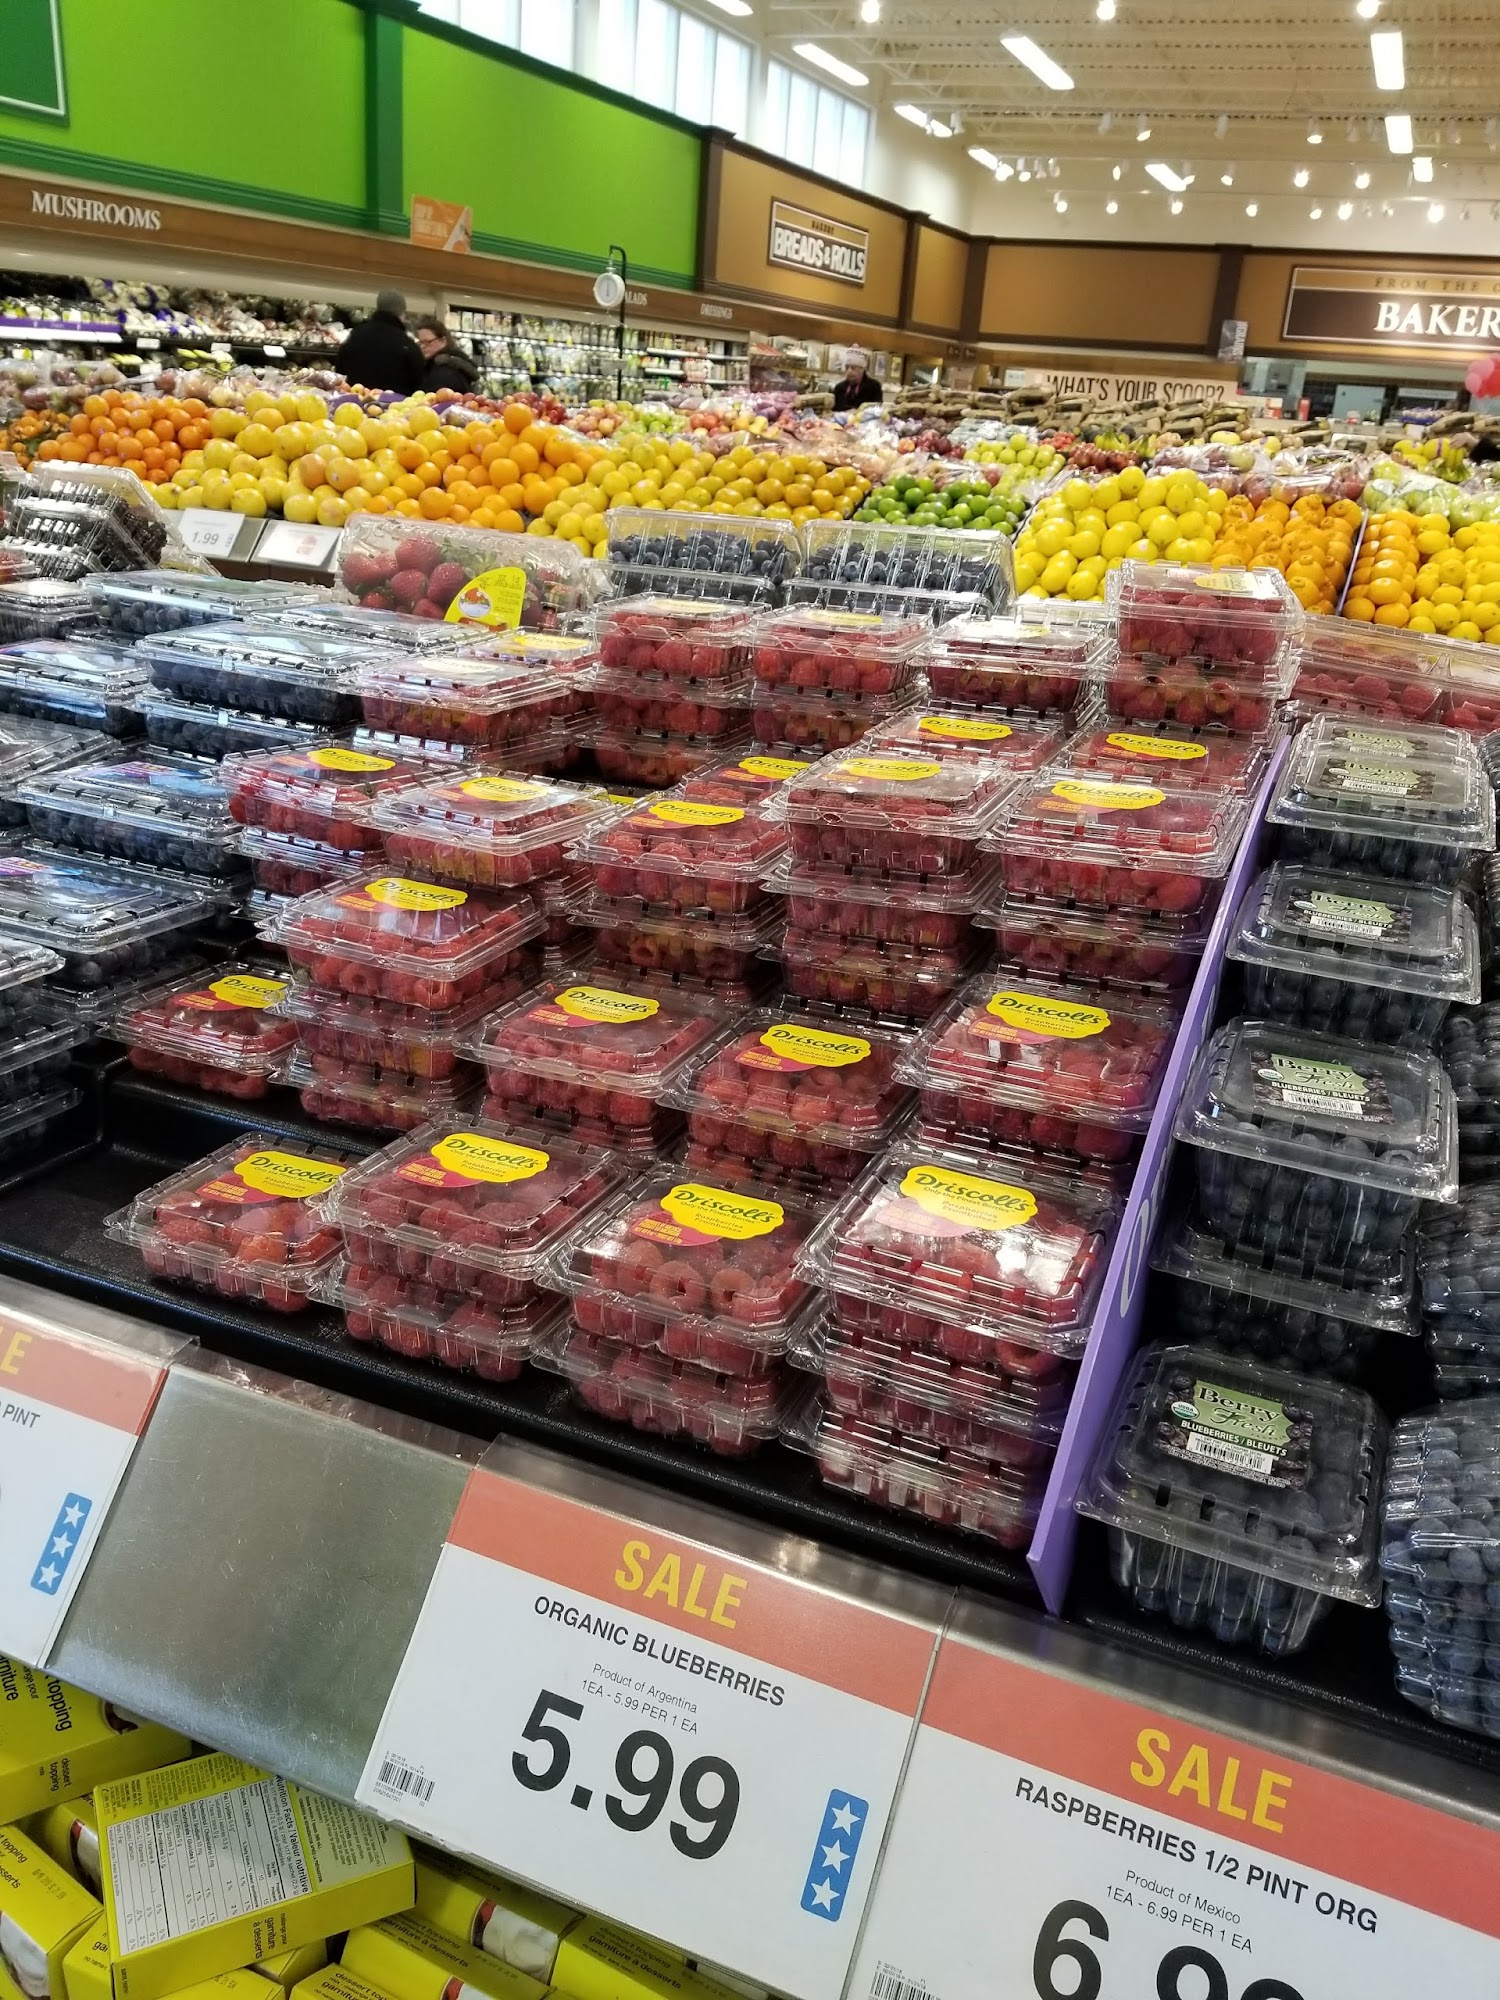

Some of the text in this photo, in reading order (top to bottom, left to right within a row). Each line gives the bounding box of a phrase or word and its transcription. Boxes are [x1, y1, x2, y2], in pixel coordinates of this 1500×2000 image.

[31, 190, 161, 230] MUSHROOMS
[773, 227, 824, 268] BREADS
[830, 244, 865, 278] ROLLS
[625, 291, 648, 306] ALADS
[1374, 277, 1428, 290] FROM
[1441, 280, 1479, 293] THE
[1373, 301, 1500, 339] BAKER
[1115, 379, 1157, 402] YOUR
[191, 531, 219, 545] 1.99
[223, 978, 274, 994] Drisco
[567, 989, 652, 1014] Driscoll's
[998, 996, 1102, 1025] Driscoll's
[770, 1028, 864, 1056] Driscoll's
[1276, 1058, 1352, 1079] Berry
[1272, 1081, 1326, 1095] BLUEBERRIES
[1333, 1091, 1370, 1102] BLEUETS
[249, 1155, 338, 1184] Driscoll's
[445, 1138, 539, 1169] Driscoll's
[673, 1189, 775, 1224] Driscoll's
[914, 1172, 1030, 1213] Driscoll's
[942, 1200, 998, 1219] Raspberries
[3, 1404, 41, 1429] PINT
[1199, 1387, 1281, 1423] Berry
[1209, 1407, 1277, 1436] Fresh
[1181, 1420, 1240, 1444] BLUEBERRIES
[1246, 1438, 1288, 1457] BLEUETS
[614, 1538, 748, 1630] SALE
[534, 1595, 786, 1707] ORGANIC BLUEBERRIES
[0, 1655, 19, 1701] arniture
[592, 1663, 697, 1713] Product of Argentina
[48, 1678, 73, 1732] topping
[582, 1679, 604, 1698] 1EA
[613, 1692, 639, 1711] 5.99
[641, 1703, 669, 1723] PER
[672, 1714, 677, 1726] 1
[681, 1718, 697, 1734] EA
[49, 1761, 60, 1792] topping
[61, 1758, 72, 1787] dessert
[511, 1687, 741, 1860] 5.99
[1130, 1728, 1293, 1834] SALE
[276, 1777, 309, 1893] Nutrition Facts Valeur nutritive
[1015, 1777, 1379, 1933] RASPBERRIES 1/2 PINT ORG
[1125, 1869, 1241, 1926] Product of Mexico
[264, 1917, 275, 1949] garniture
[1106, 1884, 1133, 1907] 1EA
[1147, 1900, 1178, 1924] 6.99
[1181, 1914, 1215, 1938] PER
[1219, 1928, 1225, 1942] 1
[1230, 1934, 1252, 1954] EA
[254, 1929, 263, 1959] desserts
[428, 1942, 469, 1968] desserts
[599, 1926, 635, 1949] dessert
[636, 1945, 672, 1970] topping
[588, 1935, 631, 1962] garniture
[640, 1963, 682, 1990] desserts
[336, 1972, 371, 1993] dessert
